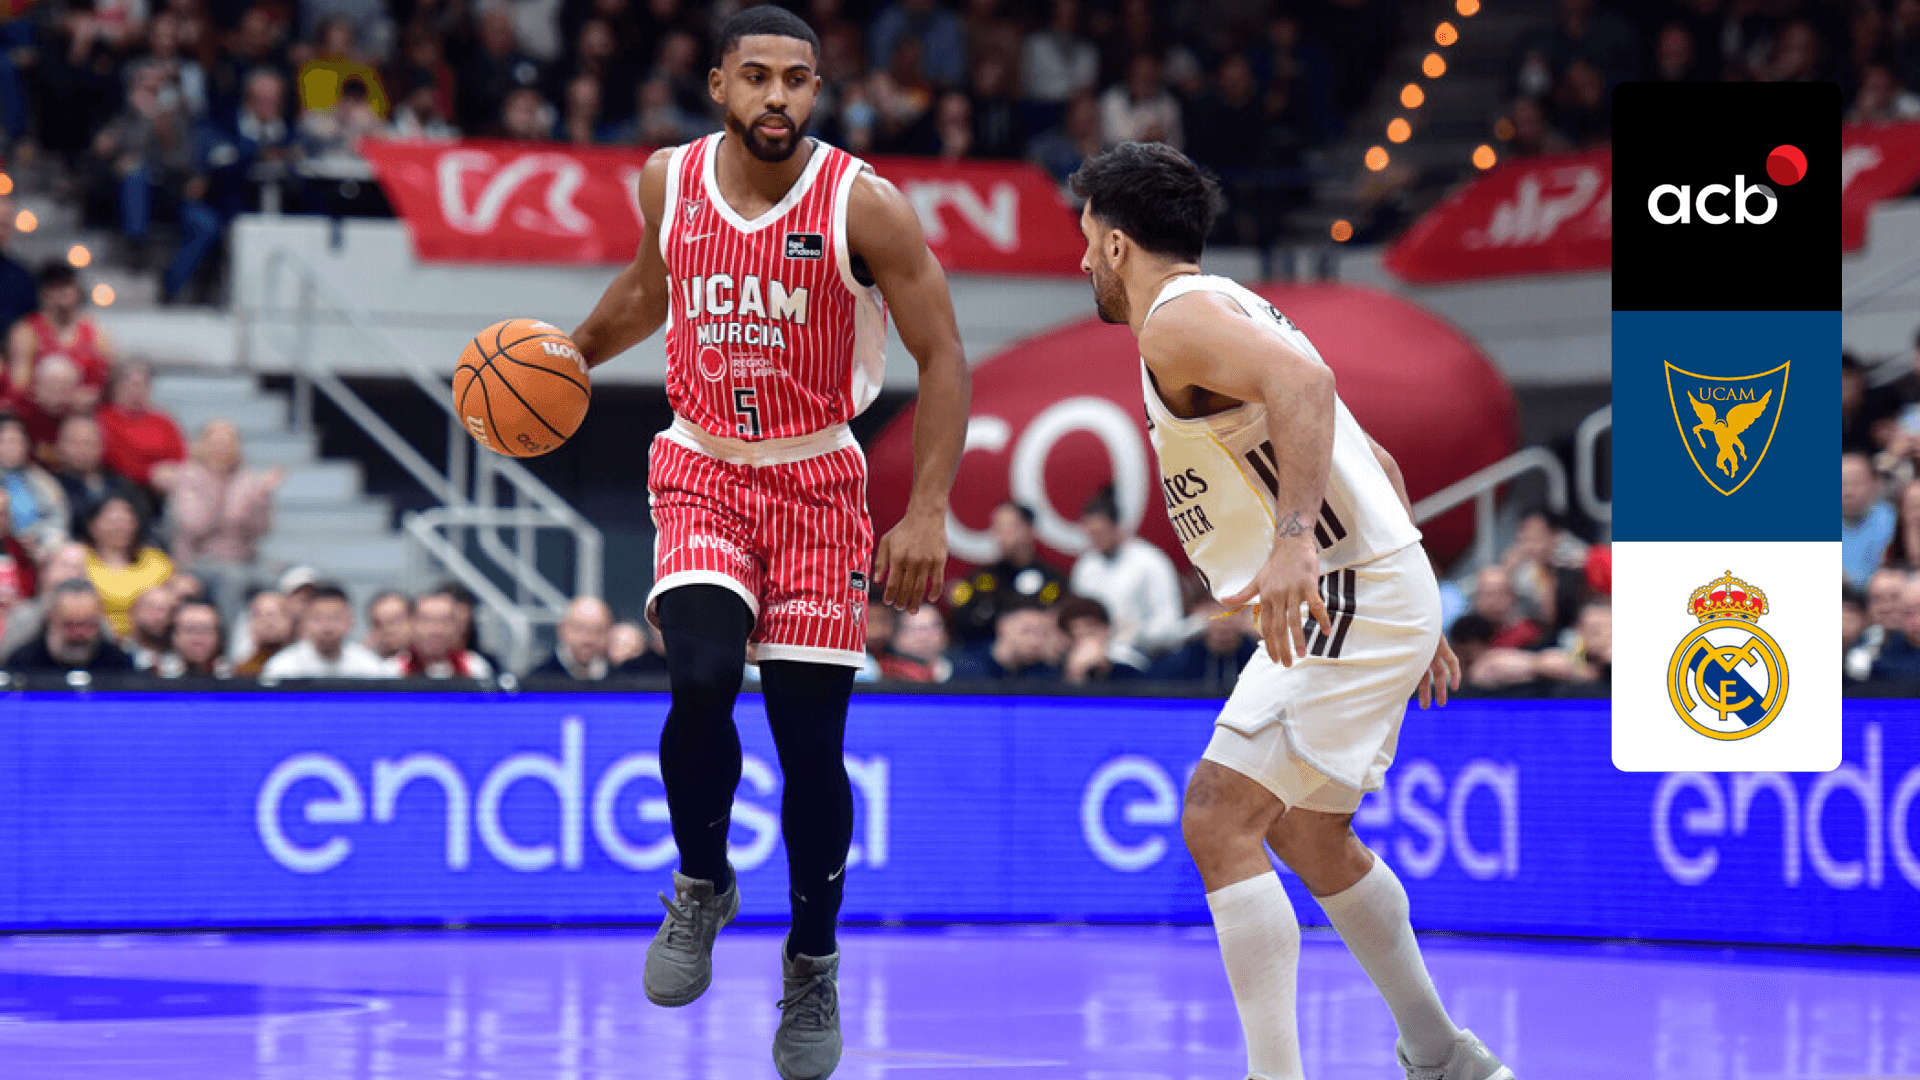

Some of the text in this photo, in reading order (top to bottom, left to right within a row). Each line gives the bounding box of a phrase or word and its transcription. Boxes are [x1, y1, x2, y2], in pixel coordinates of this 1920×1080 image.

[681, 273, 809, 326] UCAM
[697, 322, 787, 350] MURCIA
[734, 387, 762, 436] 5
